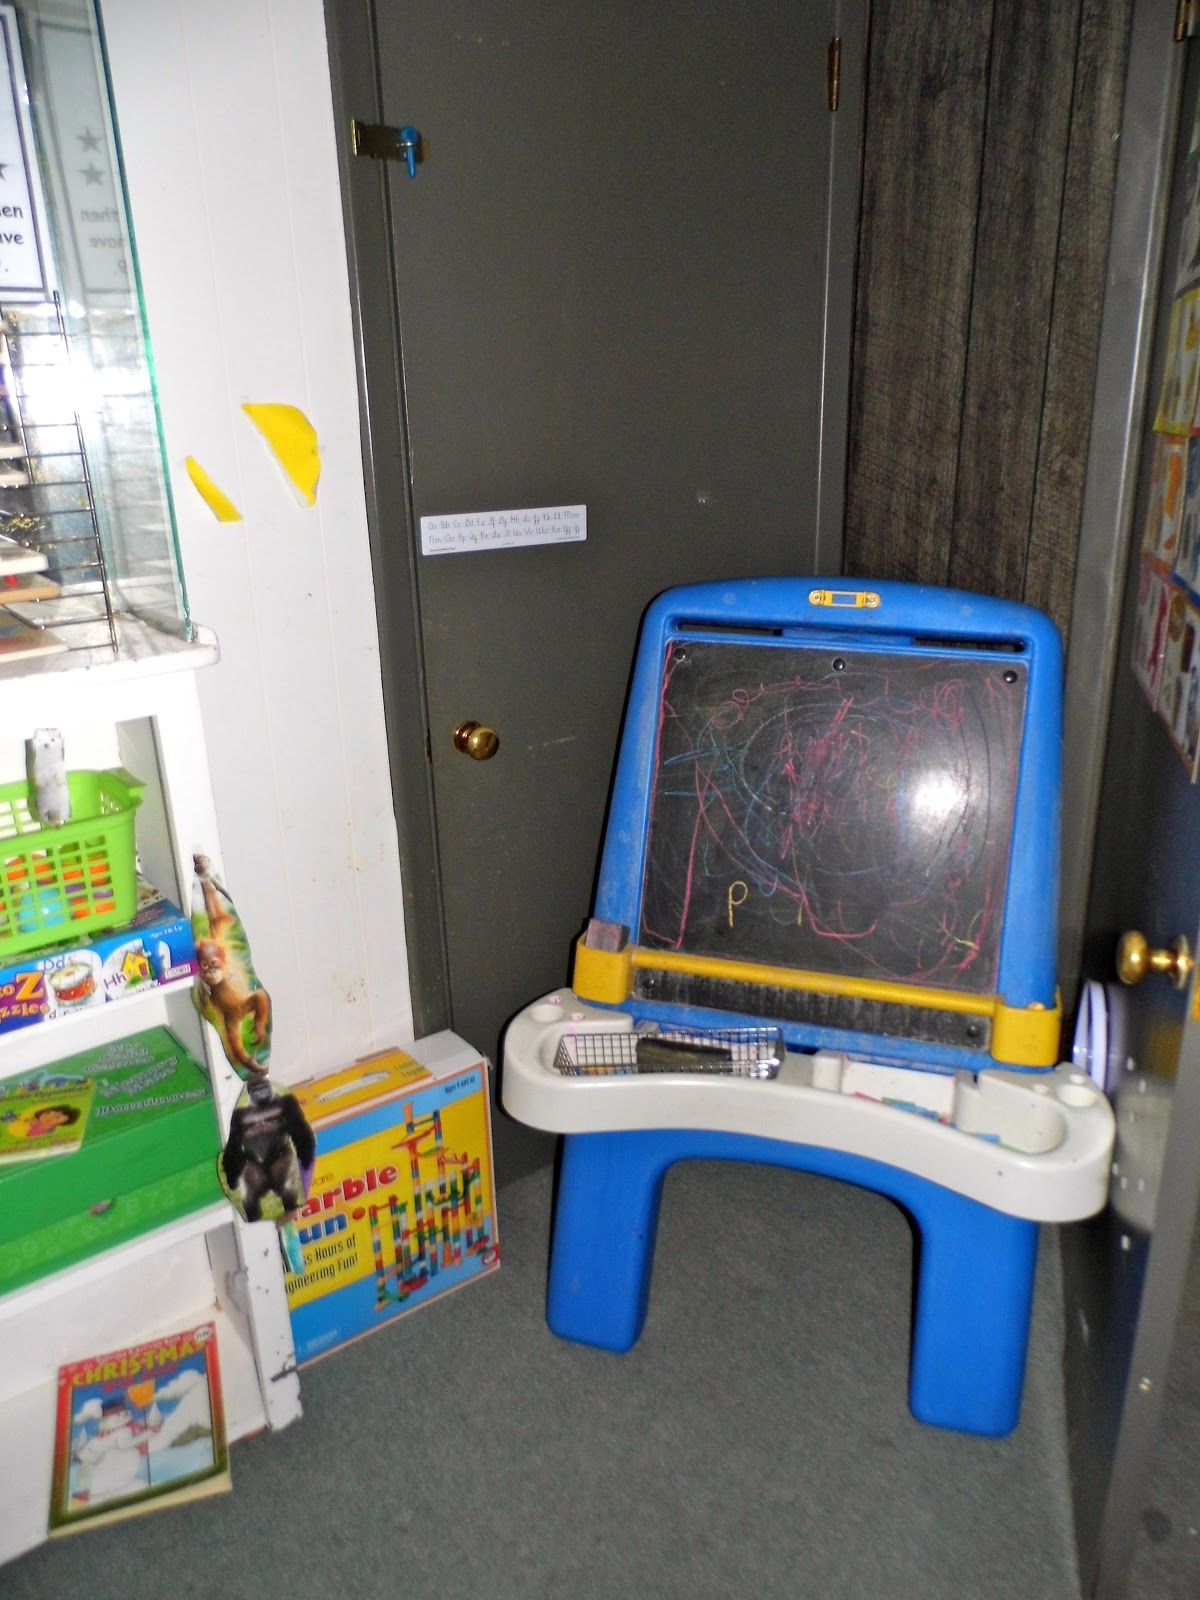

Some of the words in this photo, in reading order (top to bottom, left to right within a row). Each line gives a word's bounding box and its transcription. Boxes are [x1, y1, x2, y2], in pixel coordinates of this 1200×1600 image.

[15, 970, 45, 1000] Z
[104, 970, 126, 990] Hh
[0, 1002, 50, 1022] zzles
[294, 1165, 399, 1222] arble
[297, 1212, 348, 1246] un
[315, 1240, 344, 1261] Hours
[346, 1232, 356, 1248] of
